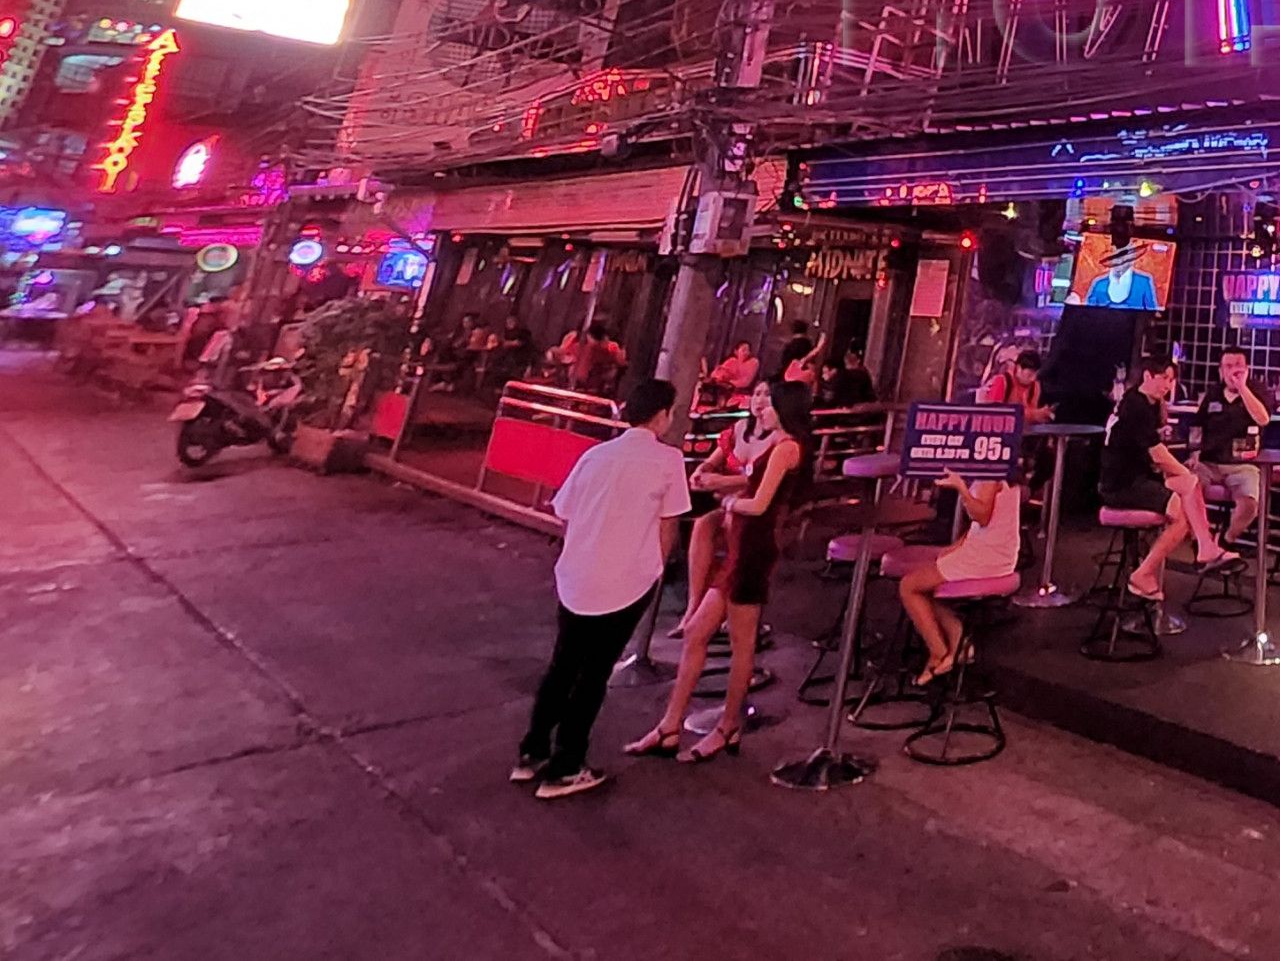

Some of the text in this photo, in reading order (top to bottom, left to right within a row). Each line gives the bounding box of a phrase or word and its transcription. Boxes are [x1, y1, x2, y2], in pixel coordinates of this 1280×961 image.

[915, 411, 1016, 434] HAPPY HOUR
[974, 436, 1002, 461] 95
